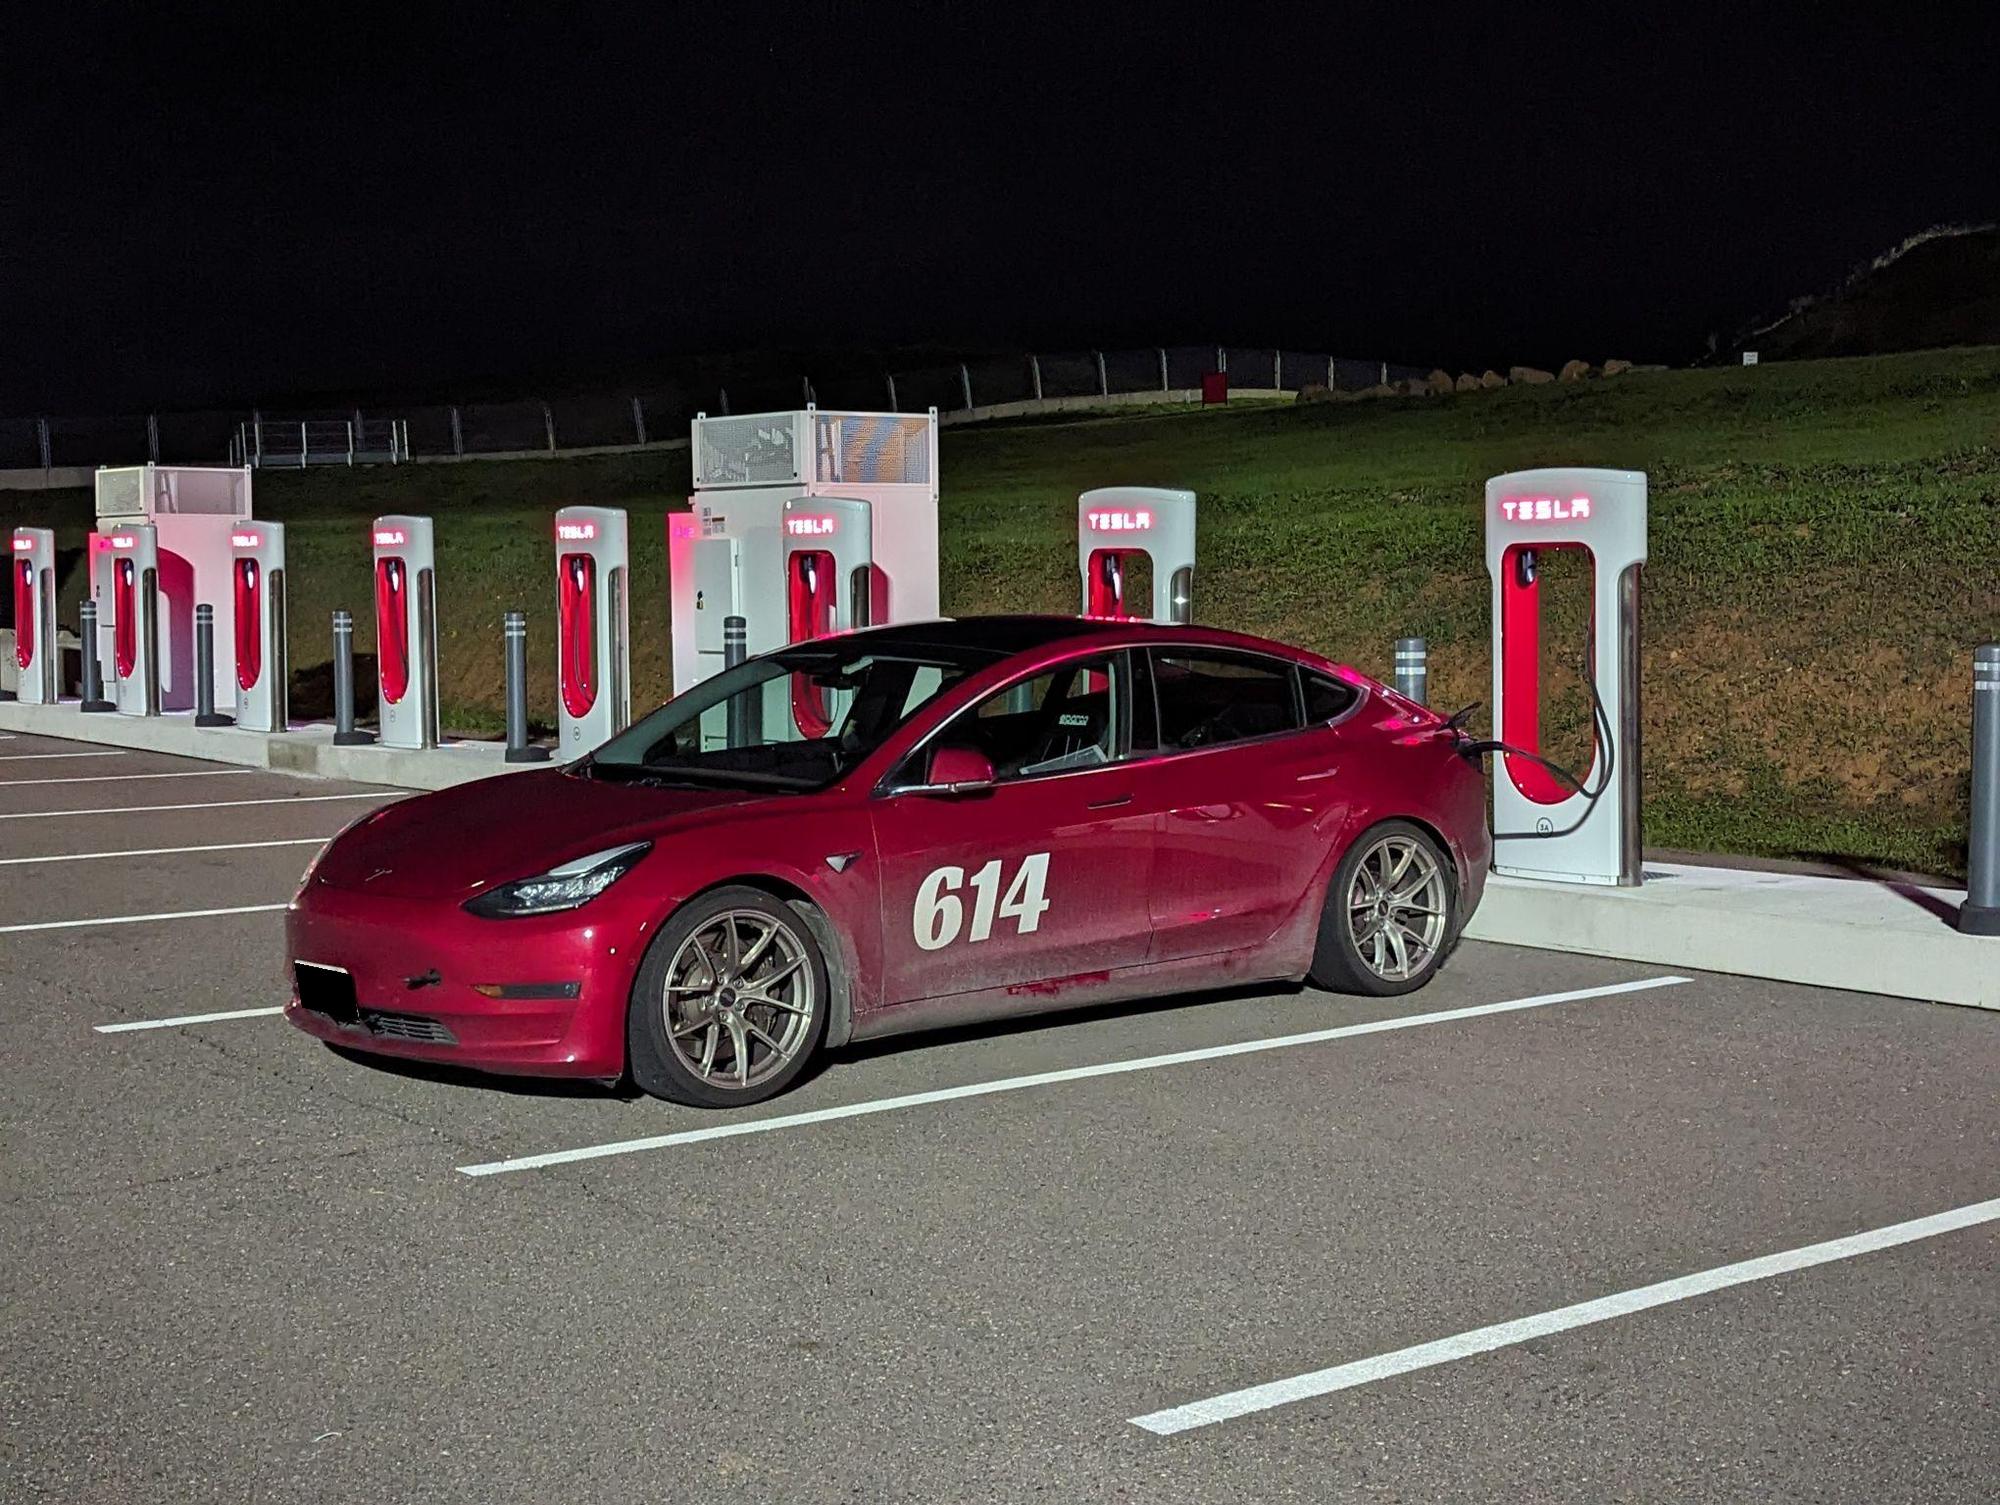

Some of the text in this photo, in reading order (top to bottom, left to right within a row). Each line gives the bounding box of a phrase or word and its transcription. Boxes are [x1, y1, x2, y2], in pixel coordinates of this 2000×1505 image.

[1502, 499, 1590, 520] TESLA
[787, 518, 833, 534] TESLA
[1088, 512, 1150, 530] TESLA
[558, 524, 594, 539] TESLA
[913, 852, 1051, 951] 614
